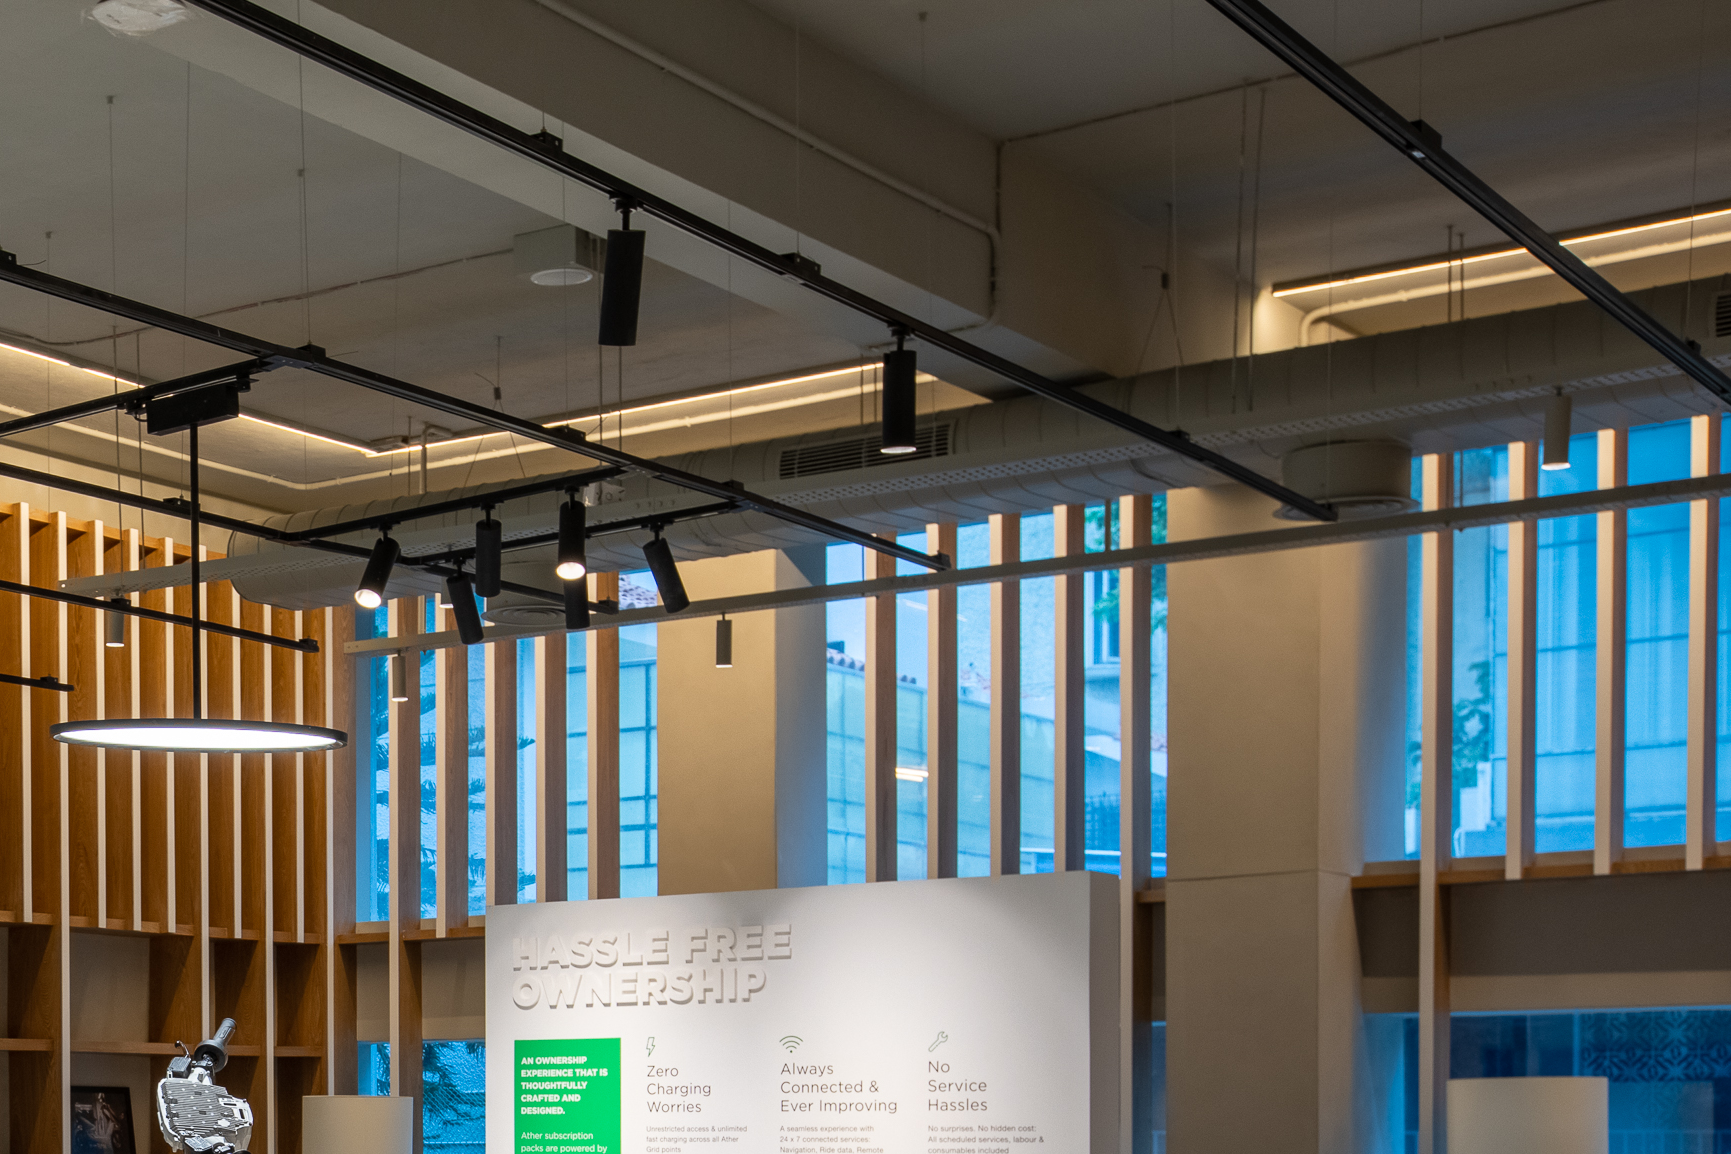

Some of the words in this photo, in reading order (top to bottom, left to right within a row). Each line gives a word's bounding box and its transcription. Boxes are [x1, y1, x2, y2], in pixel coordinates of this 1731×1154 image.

[513, 931, 669, 971] HASSLE
[685, 924, 792, 964] FREE
[513, 968, 766, 1010] OWNERSHIP
[521, 1057, 534, 1065] AN
[536, 1056, 587, 1064] OWNERSHIP
[521, 1069, 573, 1077] EXPERIENCE
[575, 1069, 598, 1077] THAT
[647, 1065, 679, 1077] Zero
[781, 1063, 833, 1077] Always
[928, 1061, 950, 1073] No
[647, 1083, 711, 1097] Charging
[781, 1081, 863, 1093] Connected
[869, 1081, 879, 1093] &
[928, 1079, 987, 1092] Service
[521, 1094, 560, 1102] CRAFTED
[562, 1094, 580, 1102] AND
[647, 1101, 702, 1112] Worries
[781, 1100, 813, 1112] Ever
[820, 1100, 897, 1114] Improving
[928, 1099, 987, 1111] Hassles
[521, 1132, 543, 1140] Ather
[545, 1132, 593, 1142] subscription
[521, 1145, 543, 1153] packs
[560, 1145, 595, 1154] powered
[597, 1145, 607, 1154] by
